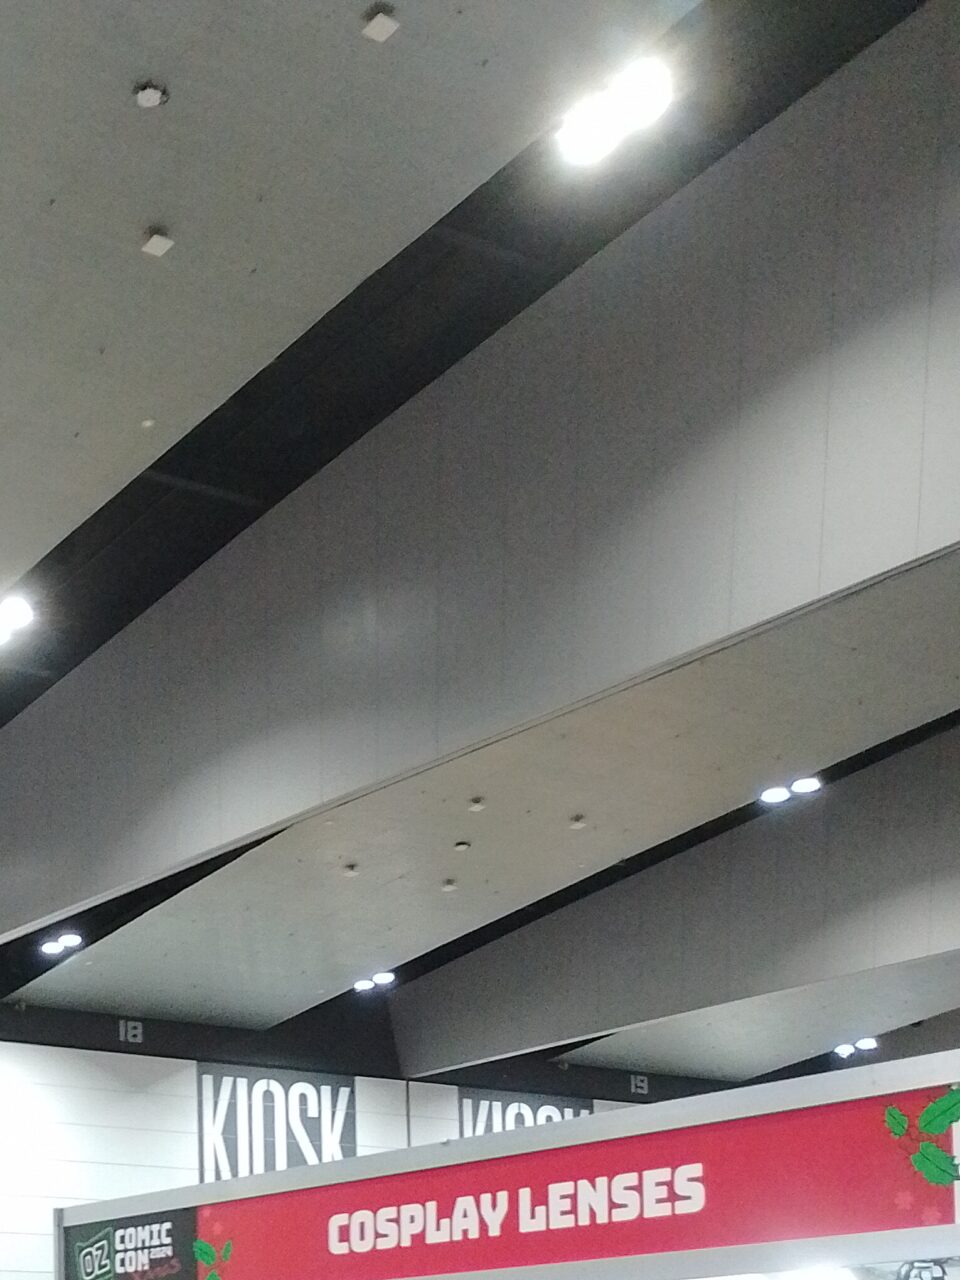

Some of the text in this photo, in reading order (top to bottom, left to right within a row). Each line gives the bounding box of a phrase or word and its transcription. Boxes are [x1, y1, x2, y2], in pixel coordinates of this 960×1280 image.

[119, 1019, 143, 1043] 18
[630, 1074, 649, 1095] 19
[202, 1074, 351, 1184] KIOSK
[327, 1162, 706, 1255] COSPLAY LENSES
[114, 1221, 172, 1251] COMIC
[80, 1240, 111, 1280] OZ
[114, 1248, 150, 1274] CON
